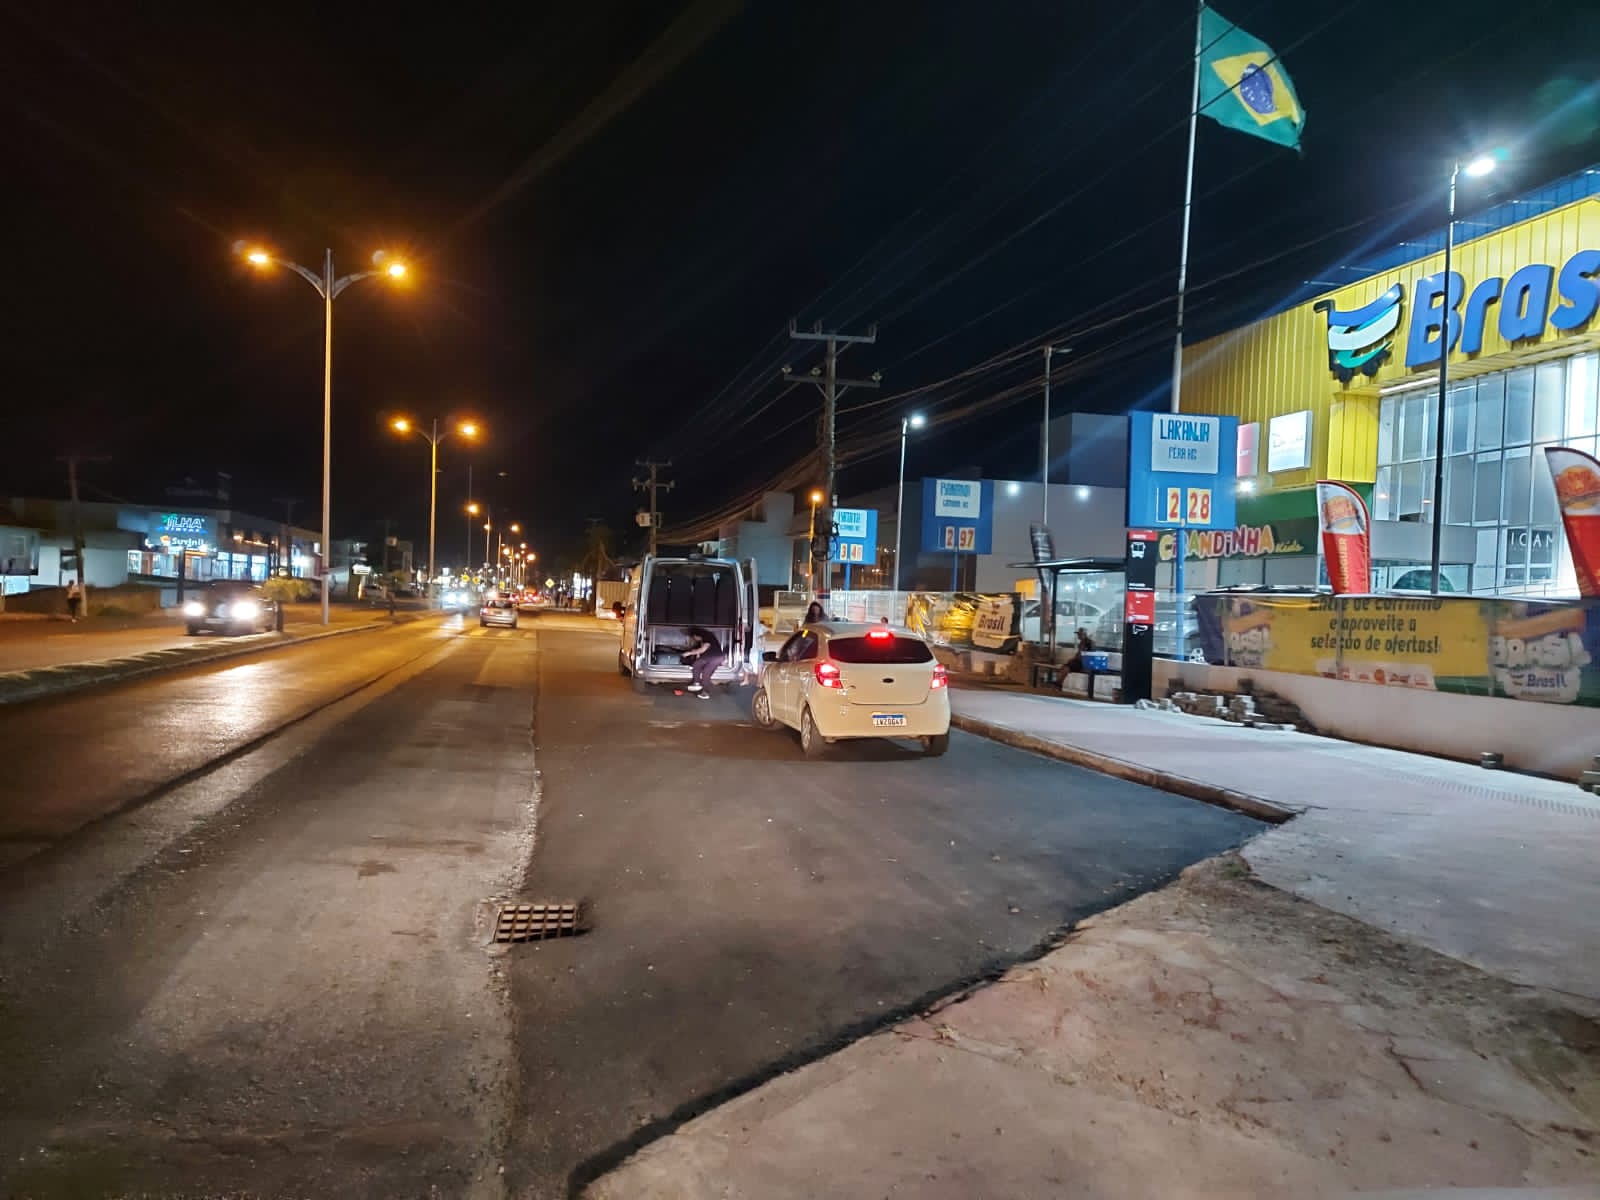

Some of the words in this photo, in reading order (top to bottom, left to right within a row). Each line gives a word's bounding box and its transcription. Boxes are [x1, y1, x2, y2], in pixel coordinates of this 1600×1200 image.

[1160, 418, 1210, 442] LARANJA
[1341, 615, 1405, 636] aproveite
[1365, 635, 1380, 650] de
